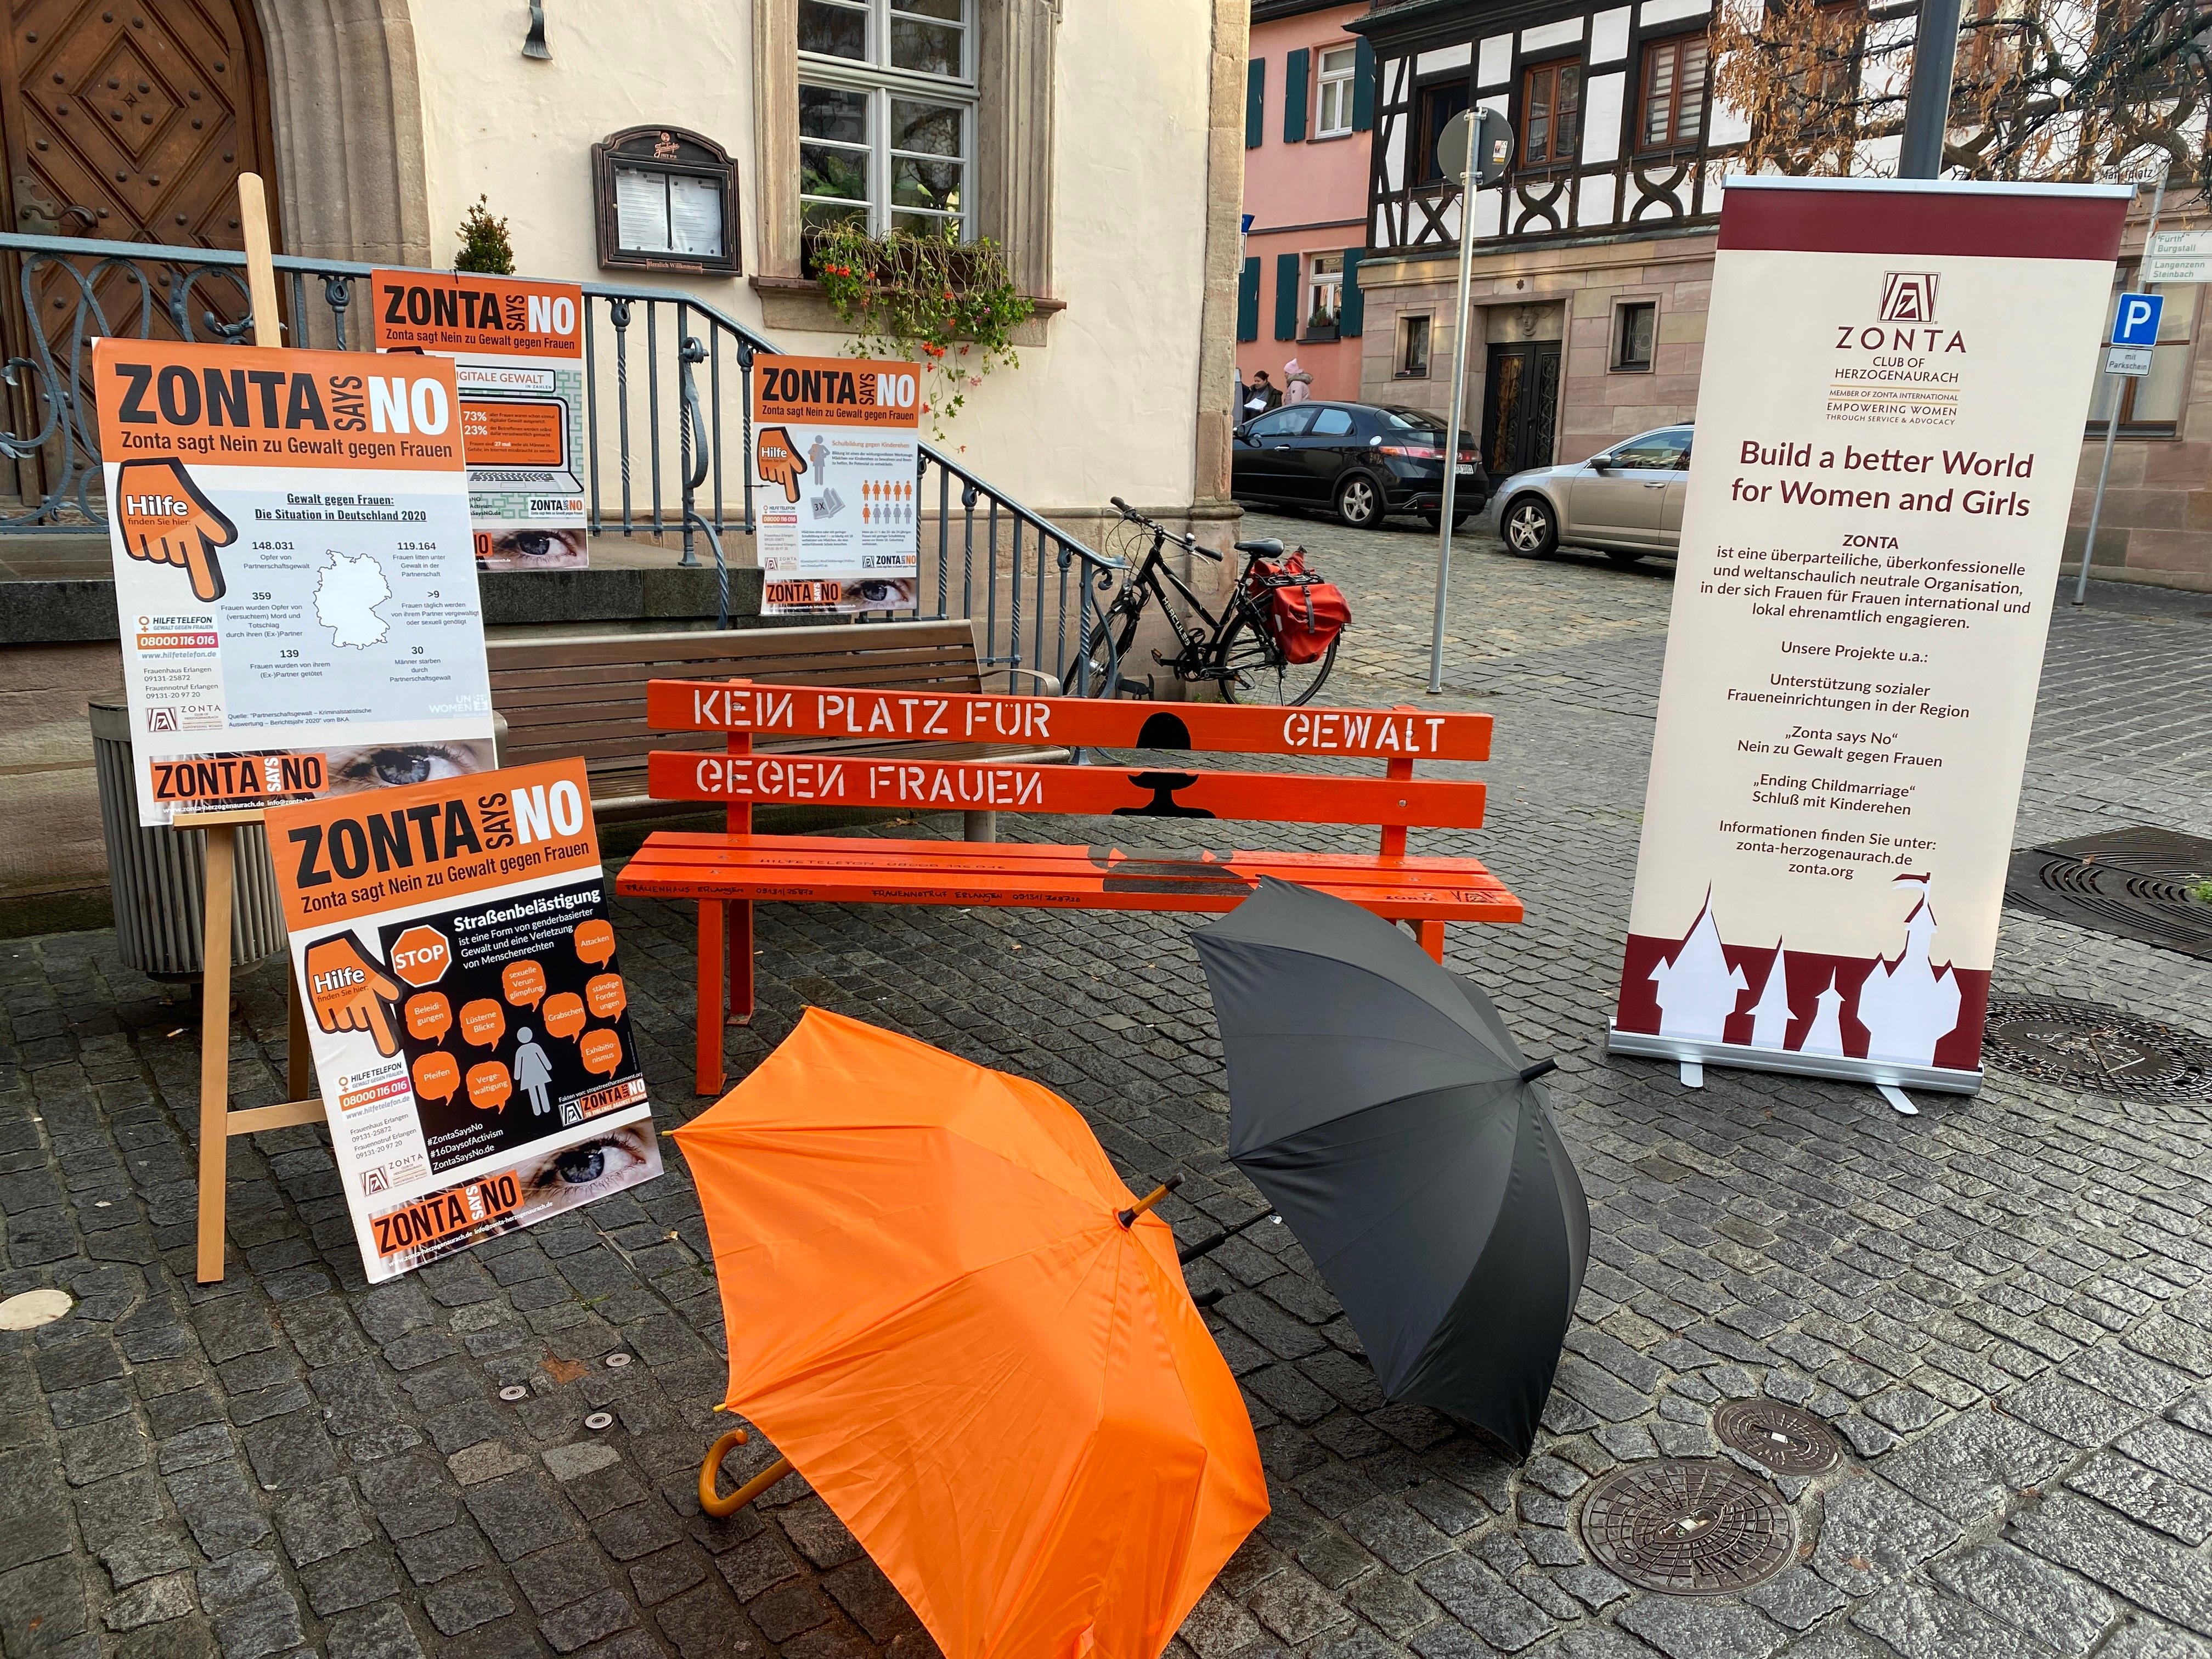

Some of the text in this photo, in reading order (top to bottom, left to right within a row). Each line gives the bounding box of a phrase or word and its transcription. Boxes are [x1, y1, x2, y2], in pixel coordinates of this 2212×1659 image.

[2158, 244, 2196, 253] Burgstall
[384, 285, 574, 335] ZONTA SAYS NO
[2124, 301, 2151, 337] P
[386, 329, 414, 340] Zonta
[417, 331, 438, 343] sagt
[441, 331, 461, 342] Nein
[479, 334, 511, 346] Gewalt
[514, 338, 541, 349] gegen
[544, 338, 574, 349] Frauen
[1836, 326, 1966, 353] ZONTA
[1873, 357, 1925, 368] CLUB OF
[2109, 360, 2147, 371] Parkschein
[456, 371, 544, 383] IGITALE GEWALT
[1836, 369, 1959, 382] HERZOGENAURACH
[763, 368, 915, 407] ZONTA SAYS NO
[115, 363, 448, 435] ZONTA SAYS NO
[1827, 403, 1956, 415] EMPOWERING WOMEN
[464, 411, 487, 421] 73%
[763, 405, 784, 415] Zonta
[787, 407, 803, 417] sagt
[806, 407, 822, 416] Nein
[837, 408, 862, 418] Gewalt
[865, 411, 887, 421] gegen
[889, 410, 913, 420] Frauen
[465, 425, 487, 435] 23%
[121, 431, 452, 459] Zonta sagt Nein zu Gewalt gegen Frauen
[762, 447, 787, 457] Hilfe
[1741, 441, 2034, 477] Build a better World
[127, 496, 187, 515] Hilfe
[287, 494, 393, 506] Gewalt gegen Frauen:
[1732, 478, 2030, 516] for Women and Girls
[255, 509, 426, 520] Die Situation in Deutschland 2020
[1843, 534, 1898, 549] ZONTA
[1717, 546, 2025, 575] ist eine überparteiliche, überkonfessionelle
[1714, 565, 2022, 596] und weltanschaulich neutrale Organisation,
[1162, 597, 1190, 646] HERCULES
[141, 636, 215, 646] 08000 116 016
[1782, 641, 1928, 662] Unsere Projekte u.a.:
[1771, 674, 1930, 696] Unterstützung sozialer
[1728, 688, 1969, 718] Fraueneinrichtungen in der Region
[695, 690, 1445, 752] KEIN PLATZ FÜR GEWALT
[1785, 726, 1832, 740] „Zonta
[1837, 733, 1866, 744] says
[697, 759, 1042, 804] GEGEN FRAUEN
[1753, 774, 1915, 798] „Ending Childmarriage“
[1752, 791, 1910, 815] Schluß mit Kinderehen
[288, 780, 583, 889] ZONTA SAYS NO
[1736, 840, 1912, 866] zonta-herzogenaurach.de
[301, 843, 589, 913] Zonta sagt Nein zu Gewalt gegen Frauen
[1788, 864, 1854, 879] zonta.org
[624, 884, 690, 893] FRAUENHAUS
[698, 886, 743, 895] ERLANGEN
[955, 891, 1002, 902] ERLANGEN
[454, 889, 601, 933] Straßenbelästigung
[580, 934, 610, 949] Attacken
[395, 945, 444, 969] STOP
[314, 968, 364, 992] Hilfe
[466, 1012, 496, 1024] Lüsterne
[548, 1006, 584, 1022] Grabschen
[474, 1023, 494, 1032] Blicke
[586, 1043, 616, 1056] Exhibitio-
[592, 1053, 614, 1063] nismus
[424, 1070, 450, 1081] Pfeifen
[427, 1123, 484, 1147] #ZontaSaysNo
[430, 1128, 504, 1158] #16DaysofActivism
[432, 1143, 495, 1171] ZontaSaysNo.de
